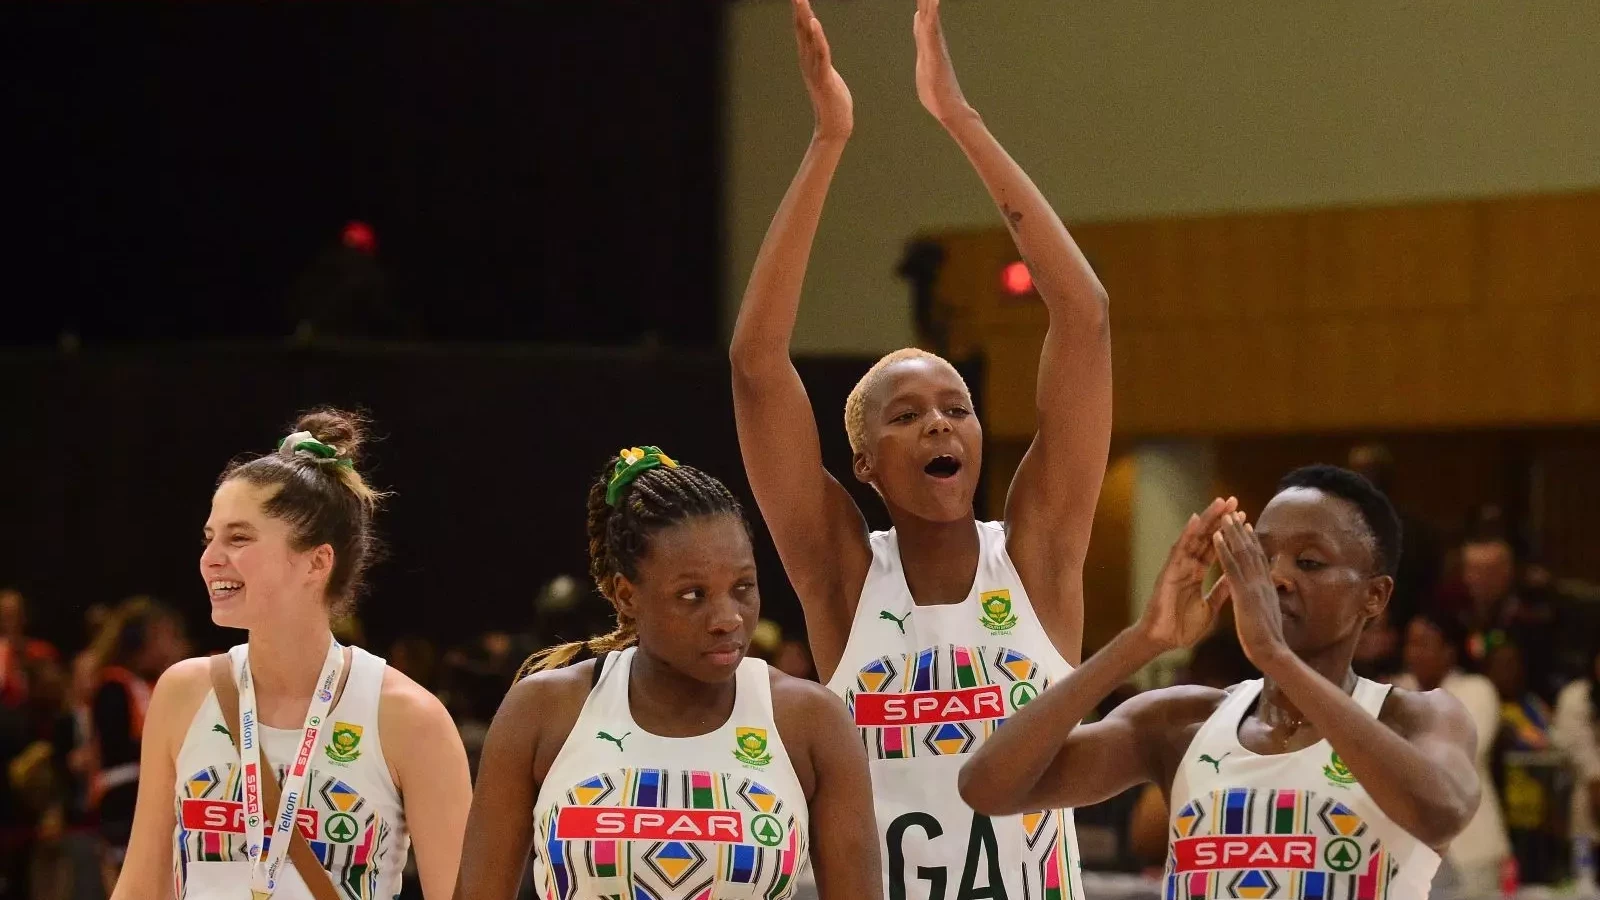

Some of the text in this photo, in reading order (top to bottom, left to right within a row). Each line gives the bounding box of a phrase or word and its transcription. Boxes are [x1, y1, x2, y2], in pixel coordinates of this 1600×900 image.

[884, 691, 1002, 721] SPAR
[243, 709, 253, 750] Telkom
[298, 728, 317, 766] SPAR
[247, 774, 258, 814] SPAR
[278, 791, 298, 833] Telkom
[596, 812, 739, 838] SPAR
[886, 811, 1010, 900] GA
[1194, 841, 1313, 866] SPAR
